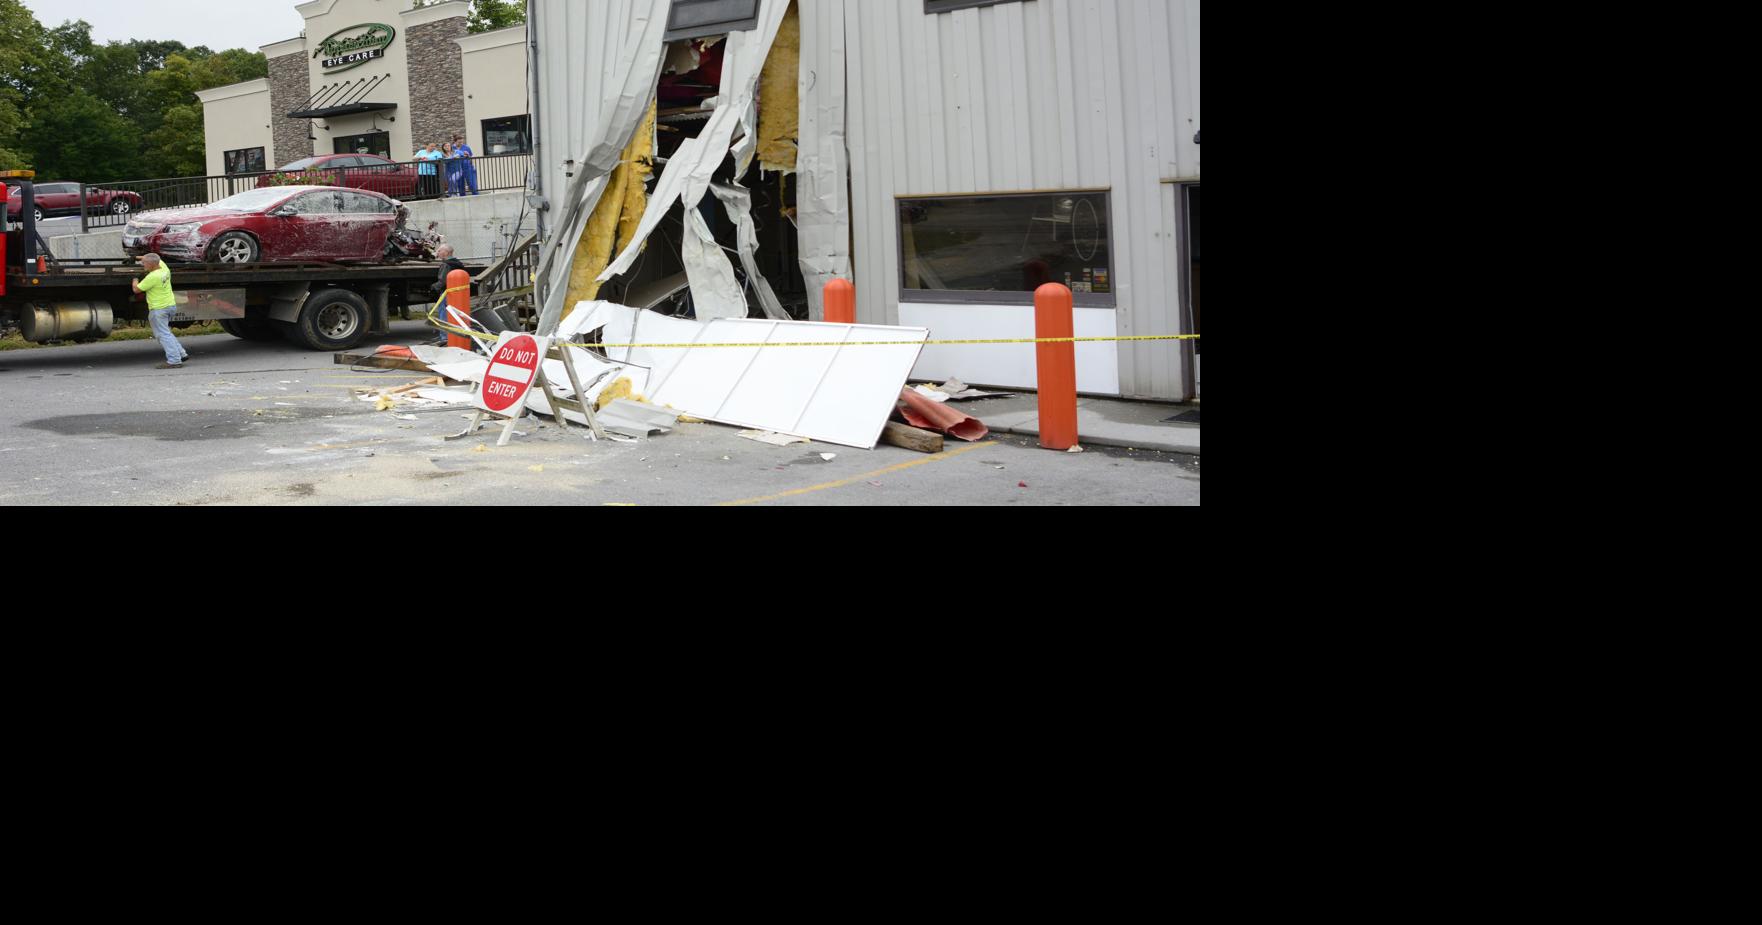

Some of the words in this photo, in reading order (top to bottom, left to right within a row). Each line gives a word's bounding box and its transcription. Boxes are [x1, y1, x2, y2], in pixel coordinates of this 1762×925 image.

[327, 57, 343, 66] EYE
[348, 50, 374, 62] CARE
[500, 347, 514, 360] DO
[514, 351, 535, 364] NOT
[488, 381, 517, 398] ENTER
